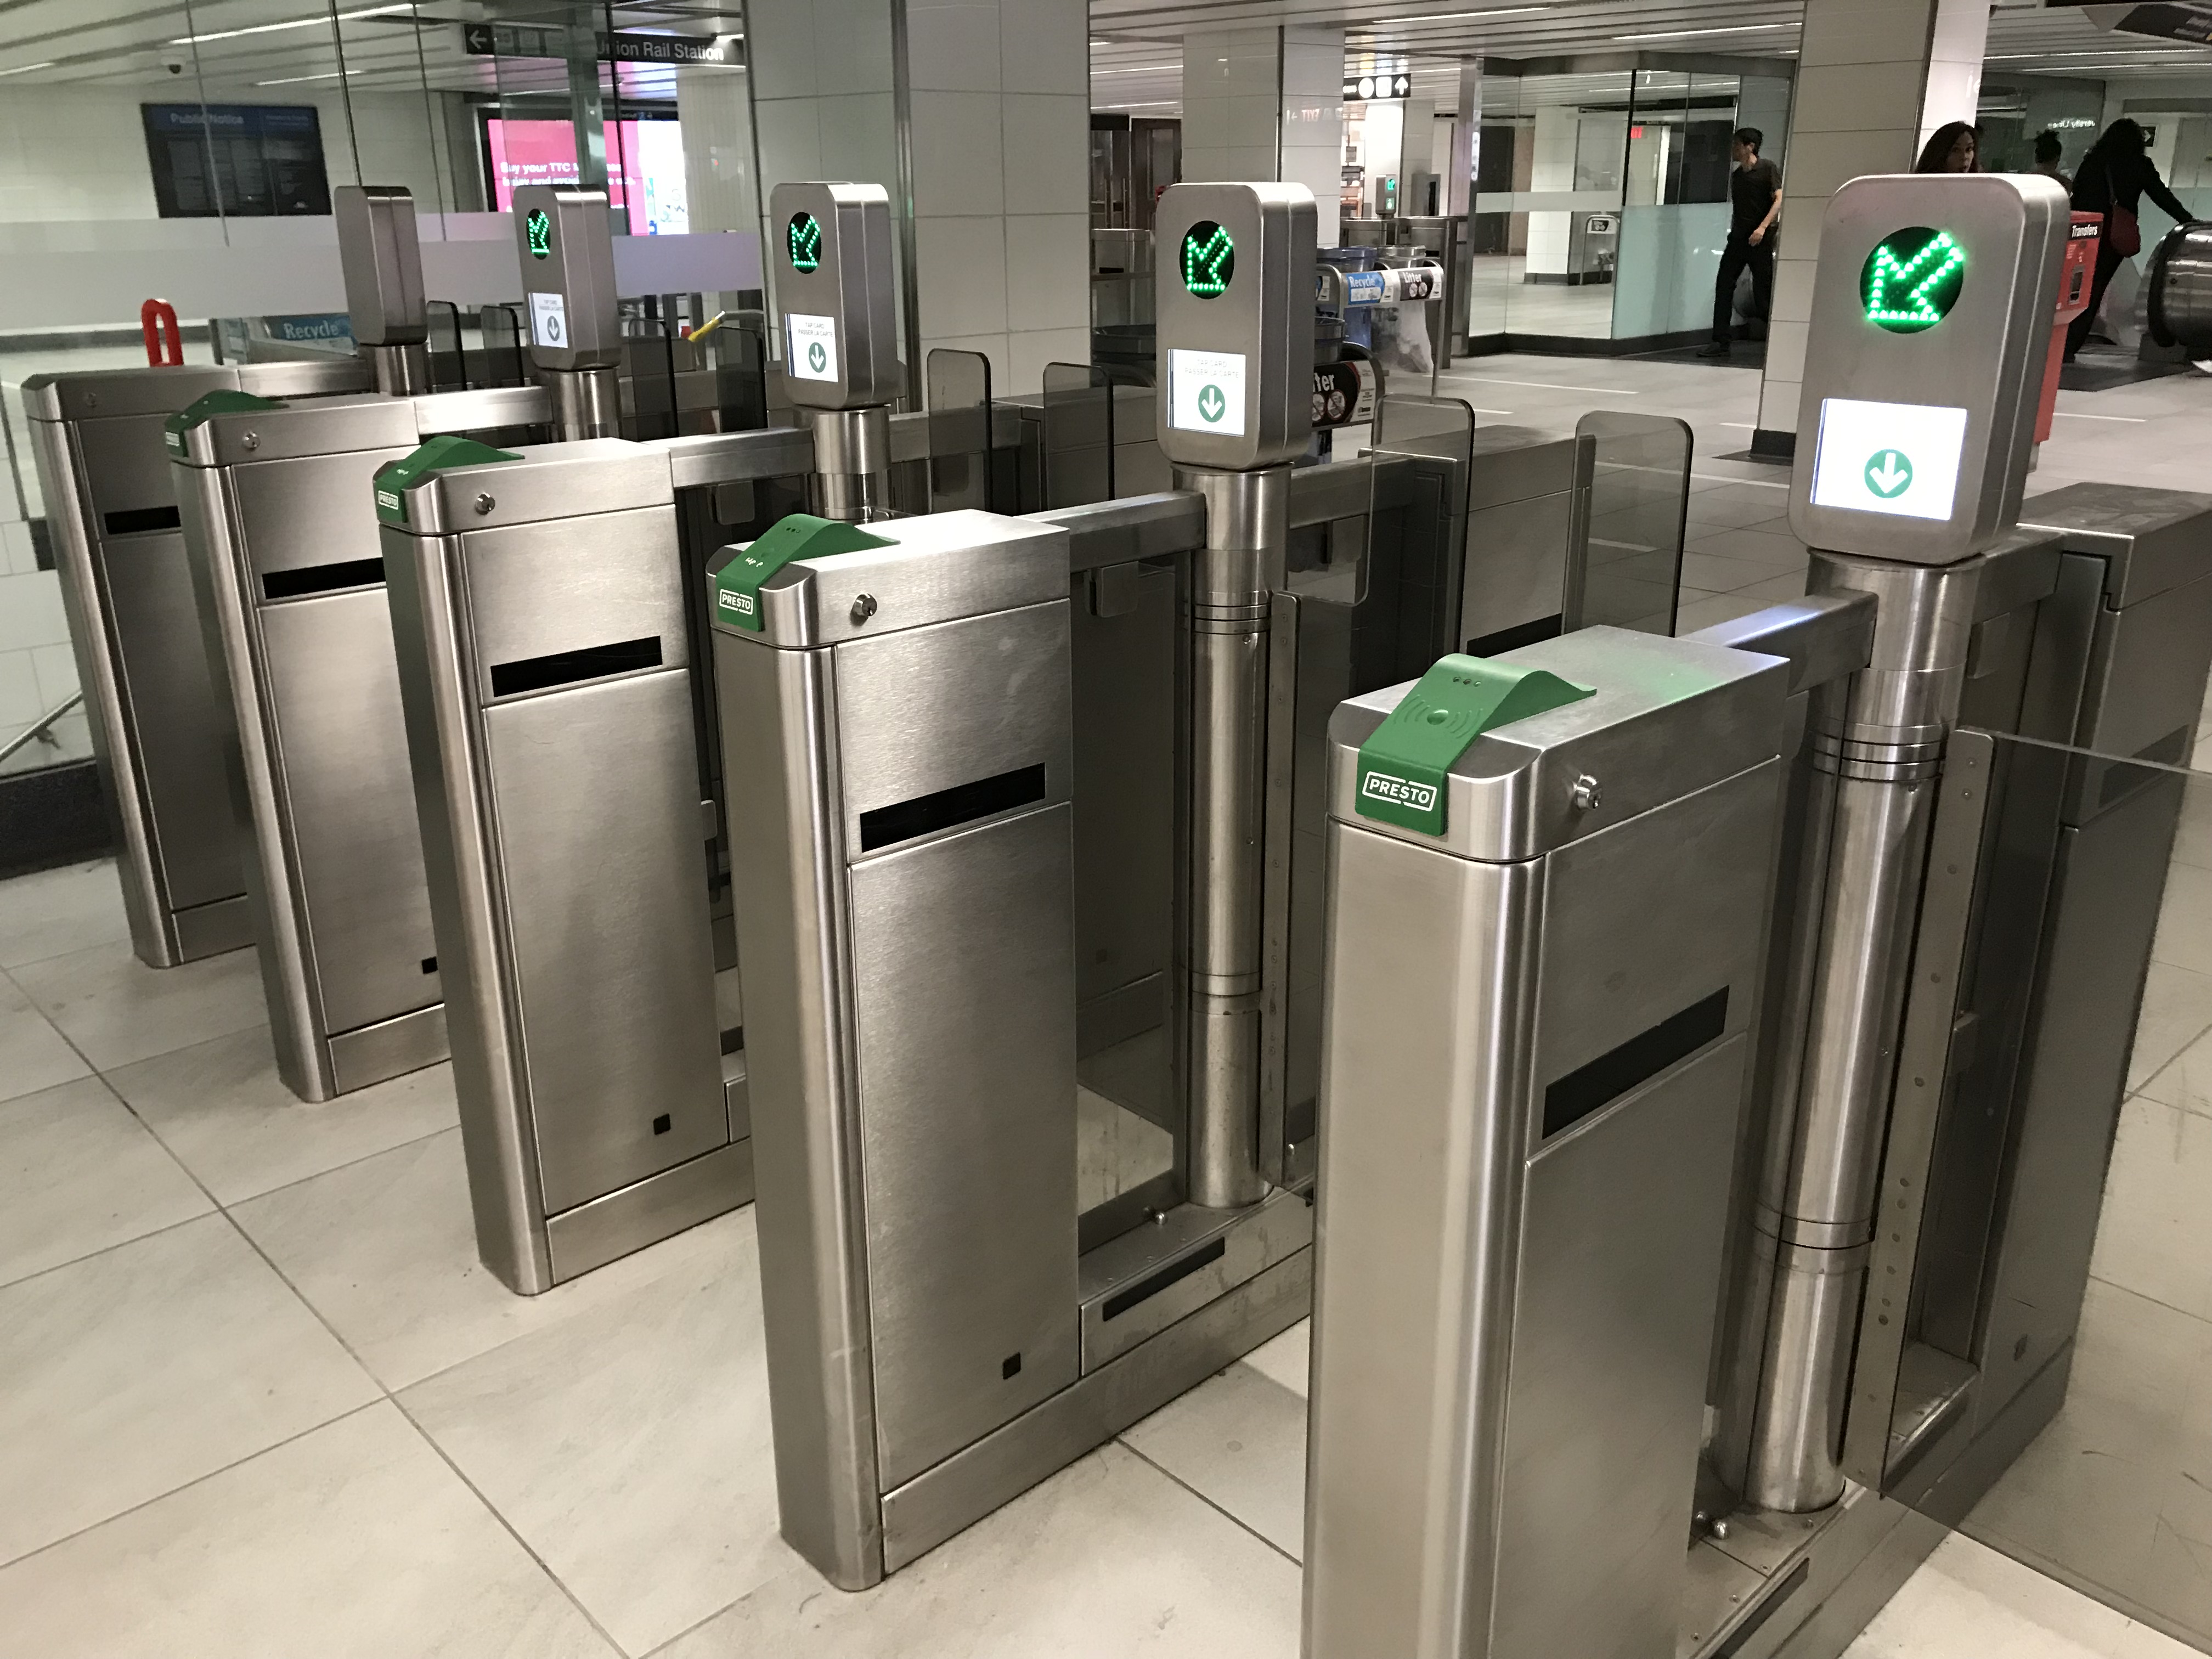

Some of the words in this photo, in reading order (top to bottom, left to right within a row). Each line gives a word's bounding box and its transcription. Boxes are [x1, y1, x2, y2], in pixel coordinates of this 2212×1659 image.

[643, 41, 670, 58] Rail
[674, 43, 724, 61] Station
[522, 164, 548, 175] your
[549, 162, 571, 172] TTC
[2072, 224, 2098, 238] Transfers
[1348, 274, 1375, 288] Recycle
[1402, 272, 1422, 283] Litter
[283, 320, 339, 339] Recycle
[722, 594, 751, 611] PRESTO
[1369, 778, 1431, 805] PRESTO
